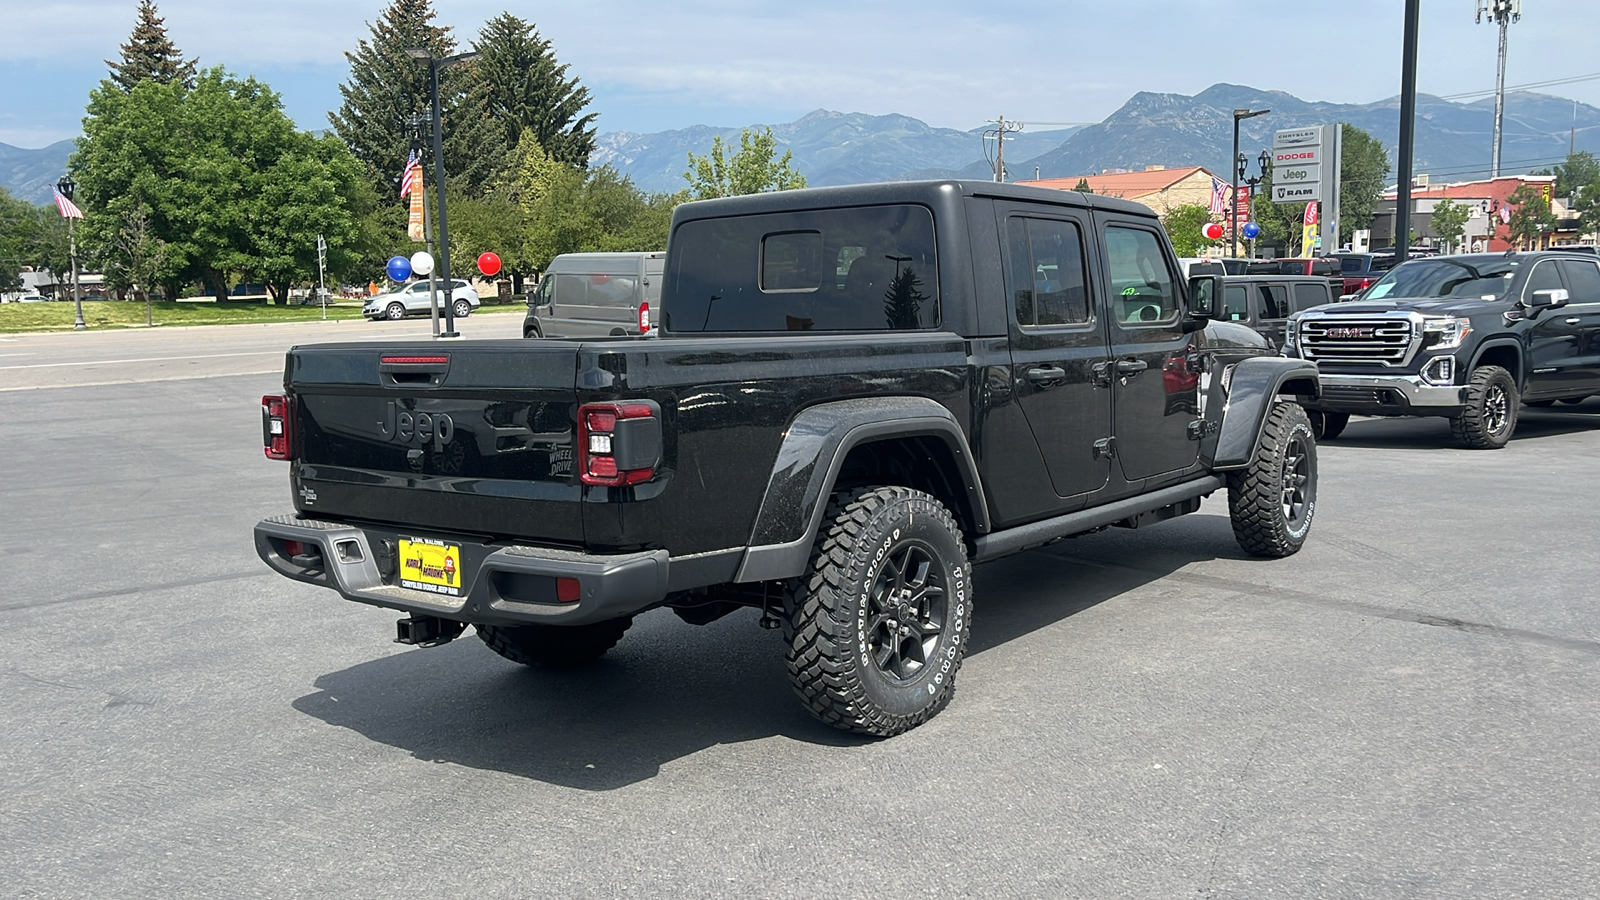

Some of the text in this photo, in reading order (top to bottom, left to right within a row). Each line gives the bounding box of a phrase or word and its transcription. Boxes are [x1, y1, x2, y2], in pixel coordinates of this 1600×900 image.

[1277, 152, 1314, 160] DODGE
[1283, 169, 1307, 180] Jeep
[1287, 188, 1312, 196] RAM
[1327, 327, 1374, 338] GMC
[377, 401, 454, 453] Jeep
[550, 450, 572, 463] WHEEL
[551, 461, 572, 476] DRIVE
